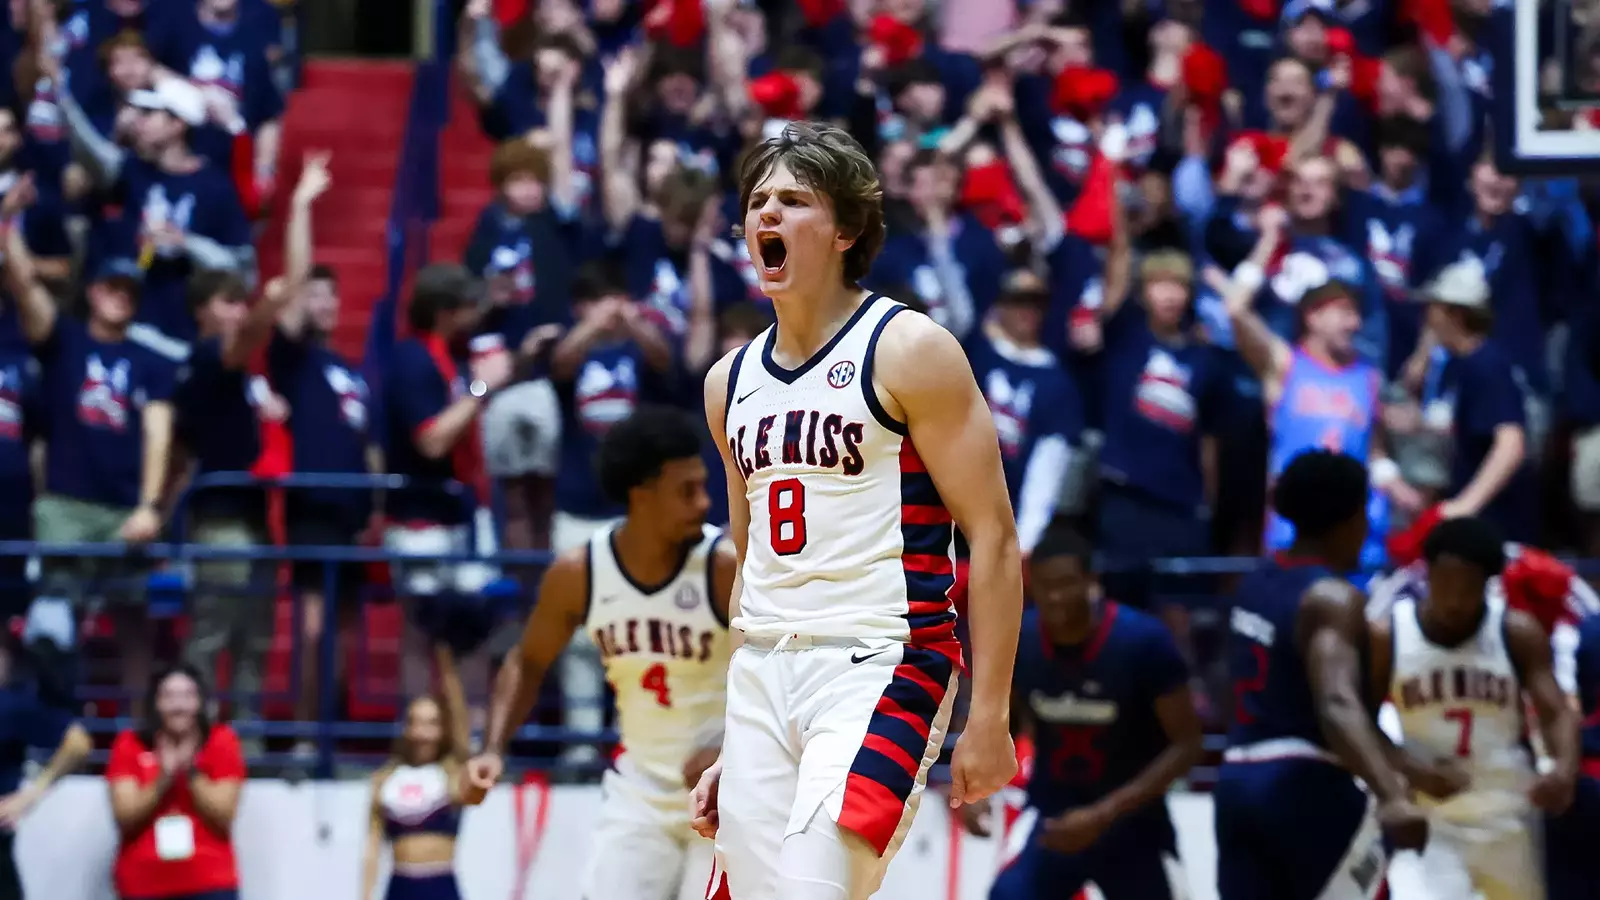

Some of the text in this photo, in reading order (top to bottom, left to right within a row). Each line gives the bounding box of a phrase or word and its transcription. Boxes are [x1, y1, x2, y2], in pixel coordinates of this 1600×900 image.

[828, 361, 855, 388] SEC
[782, 410, 864, 476] MISS
[768, 477, 807, 556] 8
[641, 663, 672, 708] 4
[1443, 708, 1472, 757] 7
